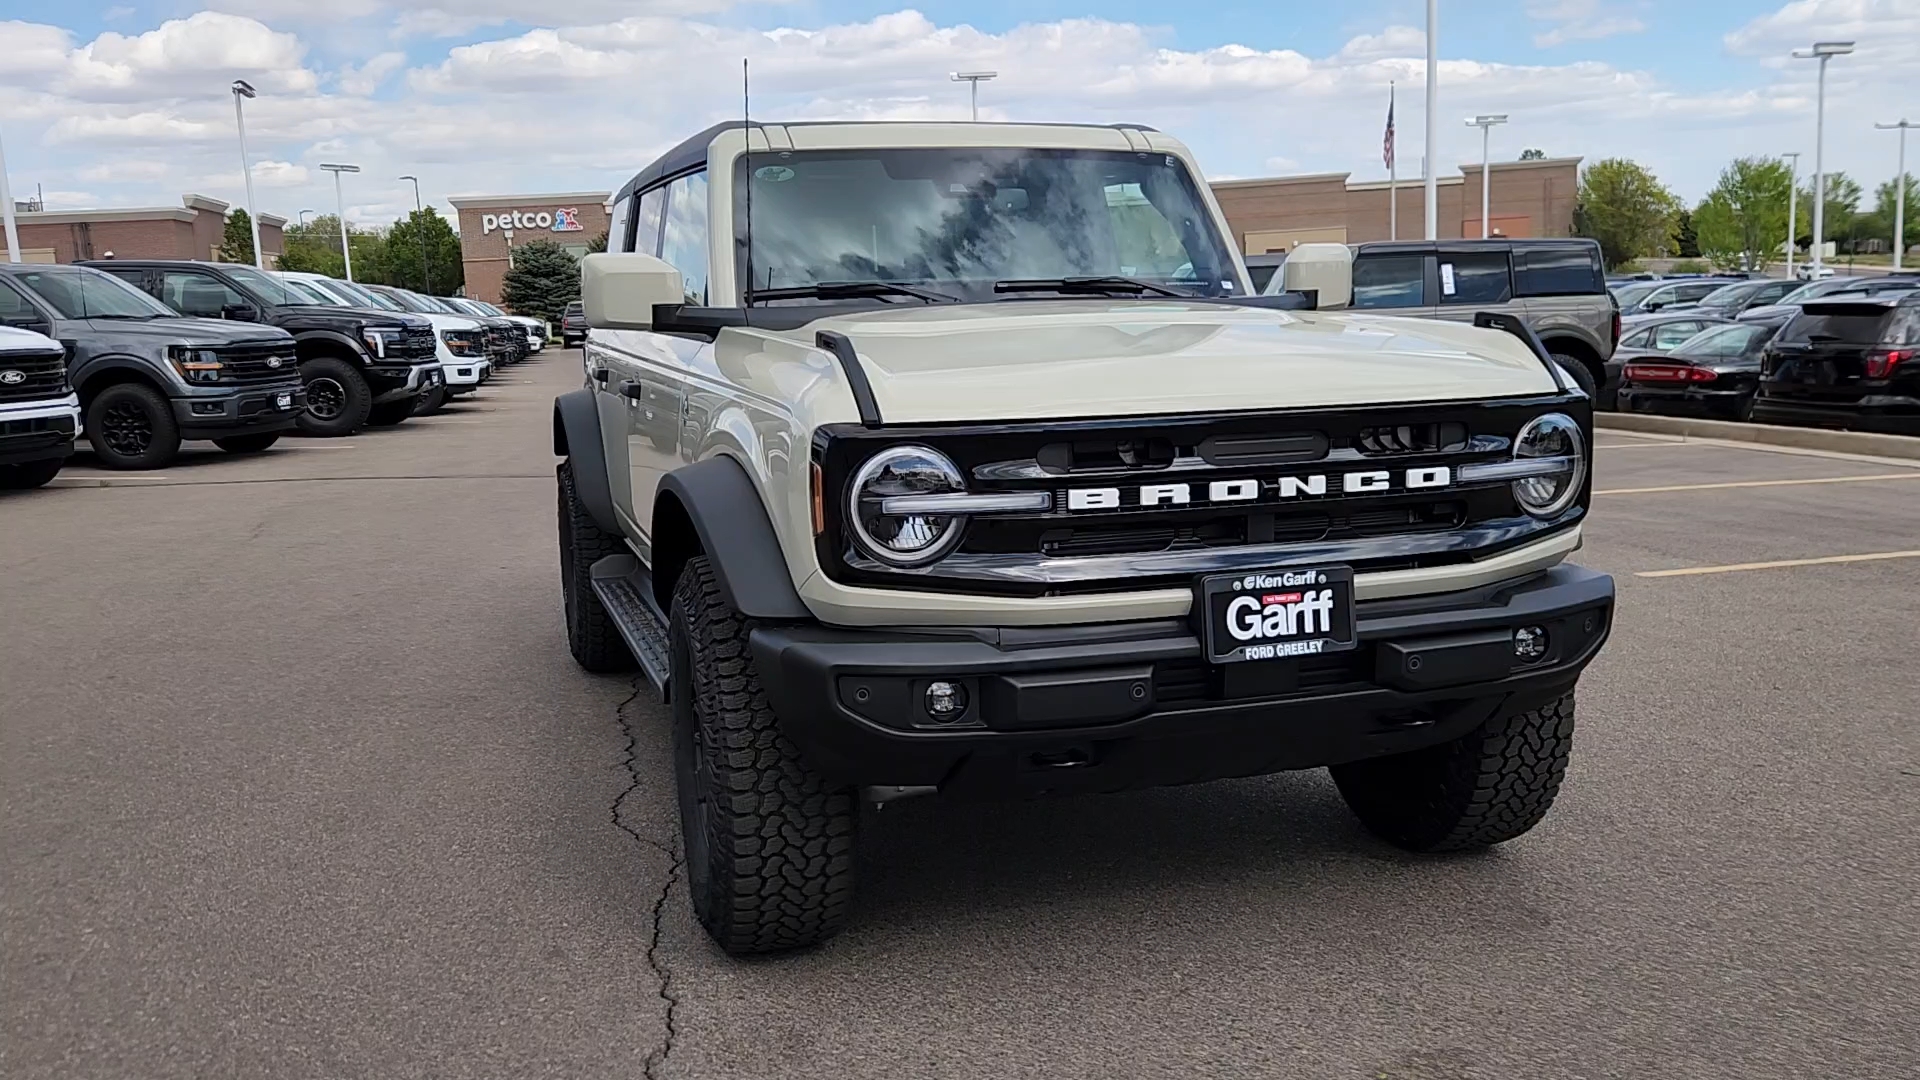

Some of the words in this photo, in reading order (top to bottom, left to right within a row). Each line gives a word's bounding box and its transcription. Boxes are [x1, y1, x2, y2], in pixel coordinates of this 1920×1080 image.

[482, 210, 552, 235] petco
[1067, 465, 1451, 510] BRONCO
[1255, 574, 1281, 589] Ken
[1283, 571, 1317, 586] Garff
[1226, 589, 1334, 640] Garff
[1245, 644, 1275, 661] FORD
[1276, 639, 1324, 657] GREELEY
